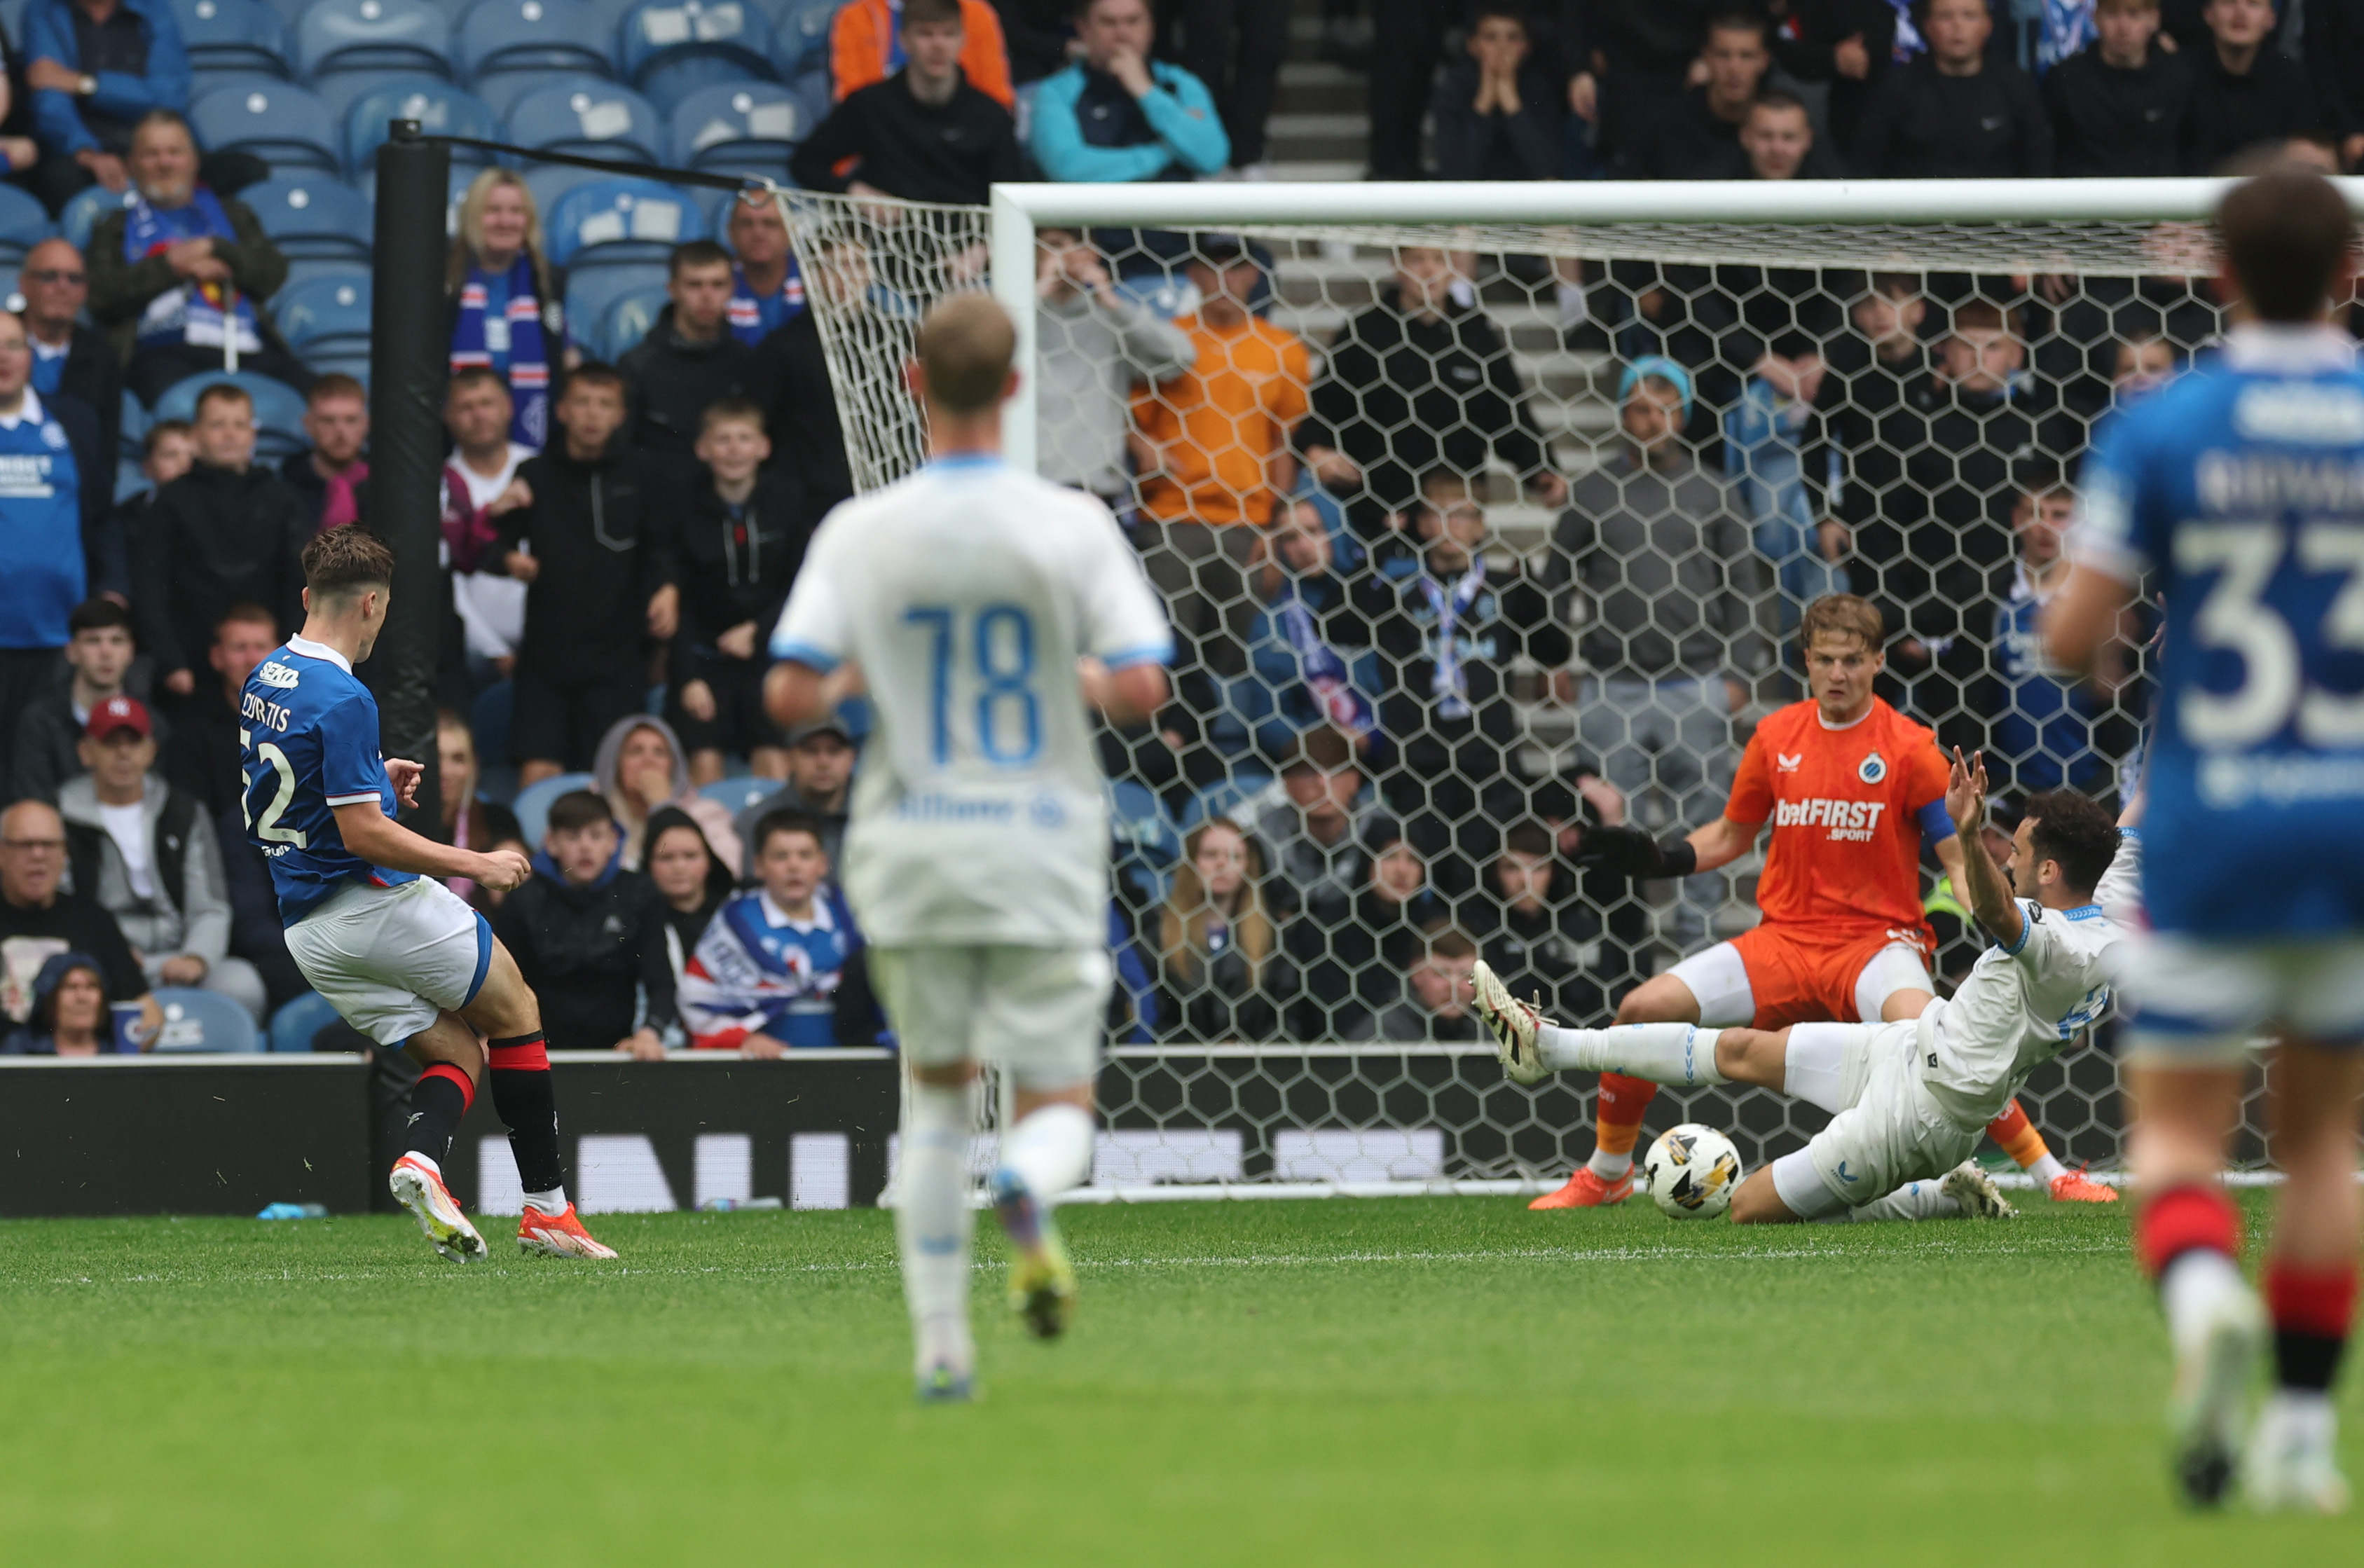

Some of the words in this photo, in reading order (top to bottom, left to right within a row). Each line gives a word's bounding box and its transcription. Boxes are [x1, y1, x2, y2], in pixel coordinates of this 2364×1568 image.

[258, 661, 300, 688] SEKO
[242, 693, 291, 732] CURTIS
[1777, 798, 1885, 830] betFIRST
[1826, 827, 1874, 842] .SPORT
